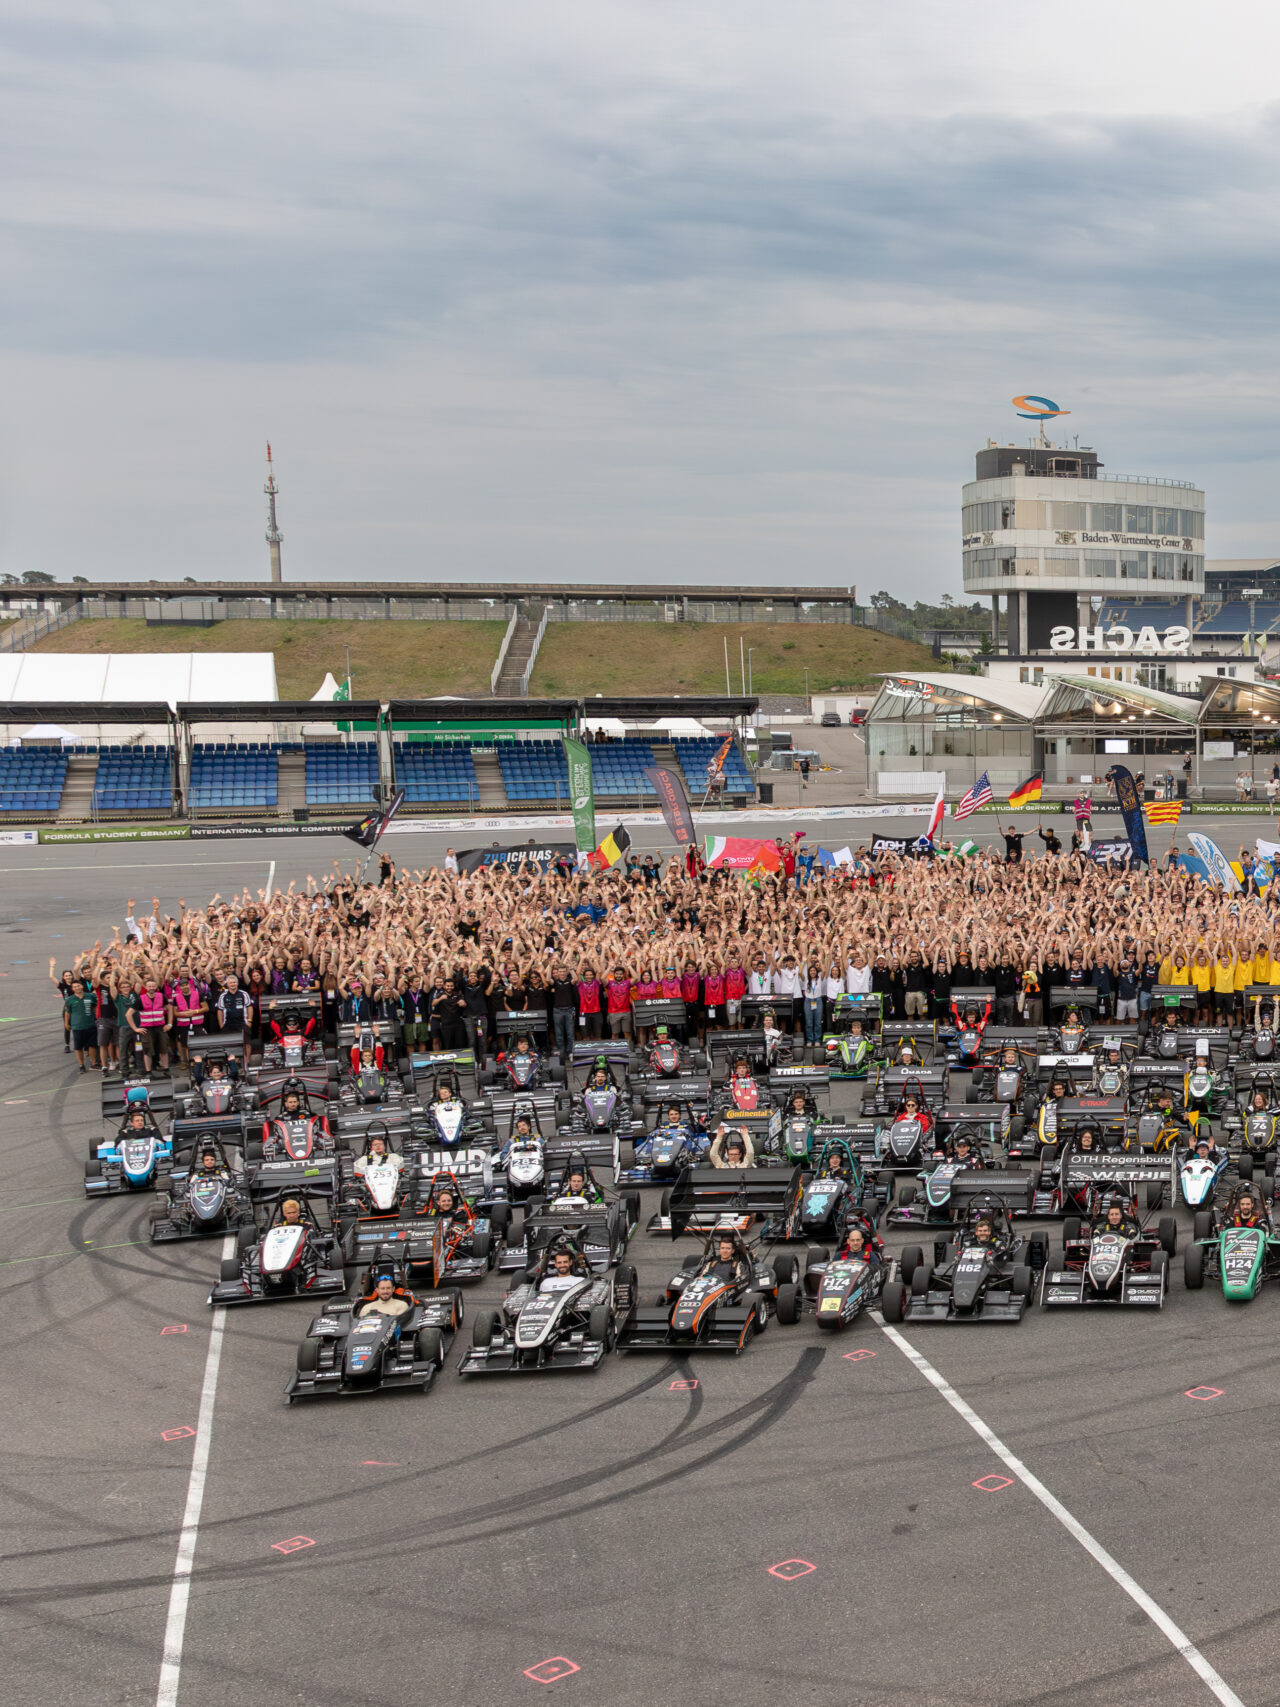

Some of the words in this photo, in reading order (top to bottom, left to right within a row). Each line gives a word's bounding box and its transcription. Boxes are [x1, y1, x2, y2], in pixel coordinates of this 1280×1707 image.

[1081, 532, 1161, 549] Baden-Württemberg
[1161, 537, 1180, 549] Center
[44, 833, 91, 842] FORMULA
[93, 831, 138, 840] STUDENT
[140, 829, 188, 839] GERMANY
[191, 827, 263, 835] INTERNATIONAL
[483, 851, 528, 864] ZURICH
[528, 850, 552, 861] UAS
[726, 1108, 768, 1120] Continental
[1253, 1122, 1267, 1130] 76
[261, 1157, 336, 1170] FASTTUBE
[1071, 1156, 1099, 1164] OTH
[1102, 1155, 1171, 1166] Regensburg
[1091, 1171, 1171, 1180] WETHJE
[956, 1264, 982, 1273] H62
[1225, 1258, 1253, 1269] H24
[823, 1277, 851, 1287] H74
